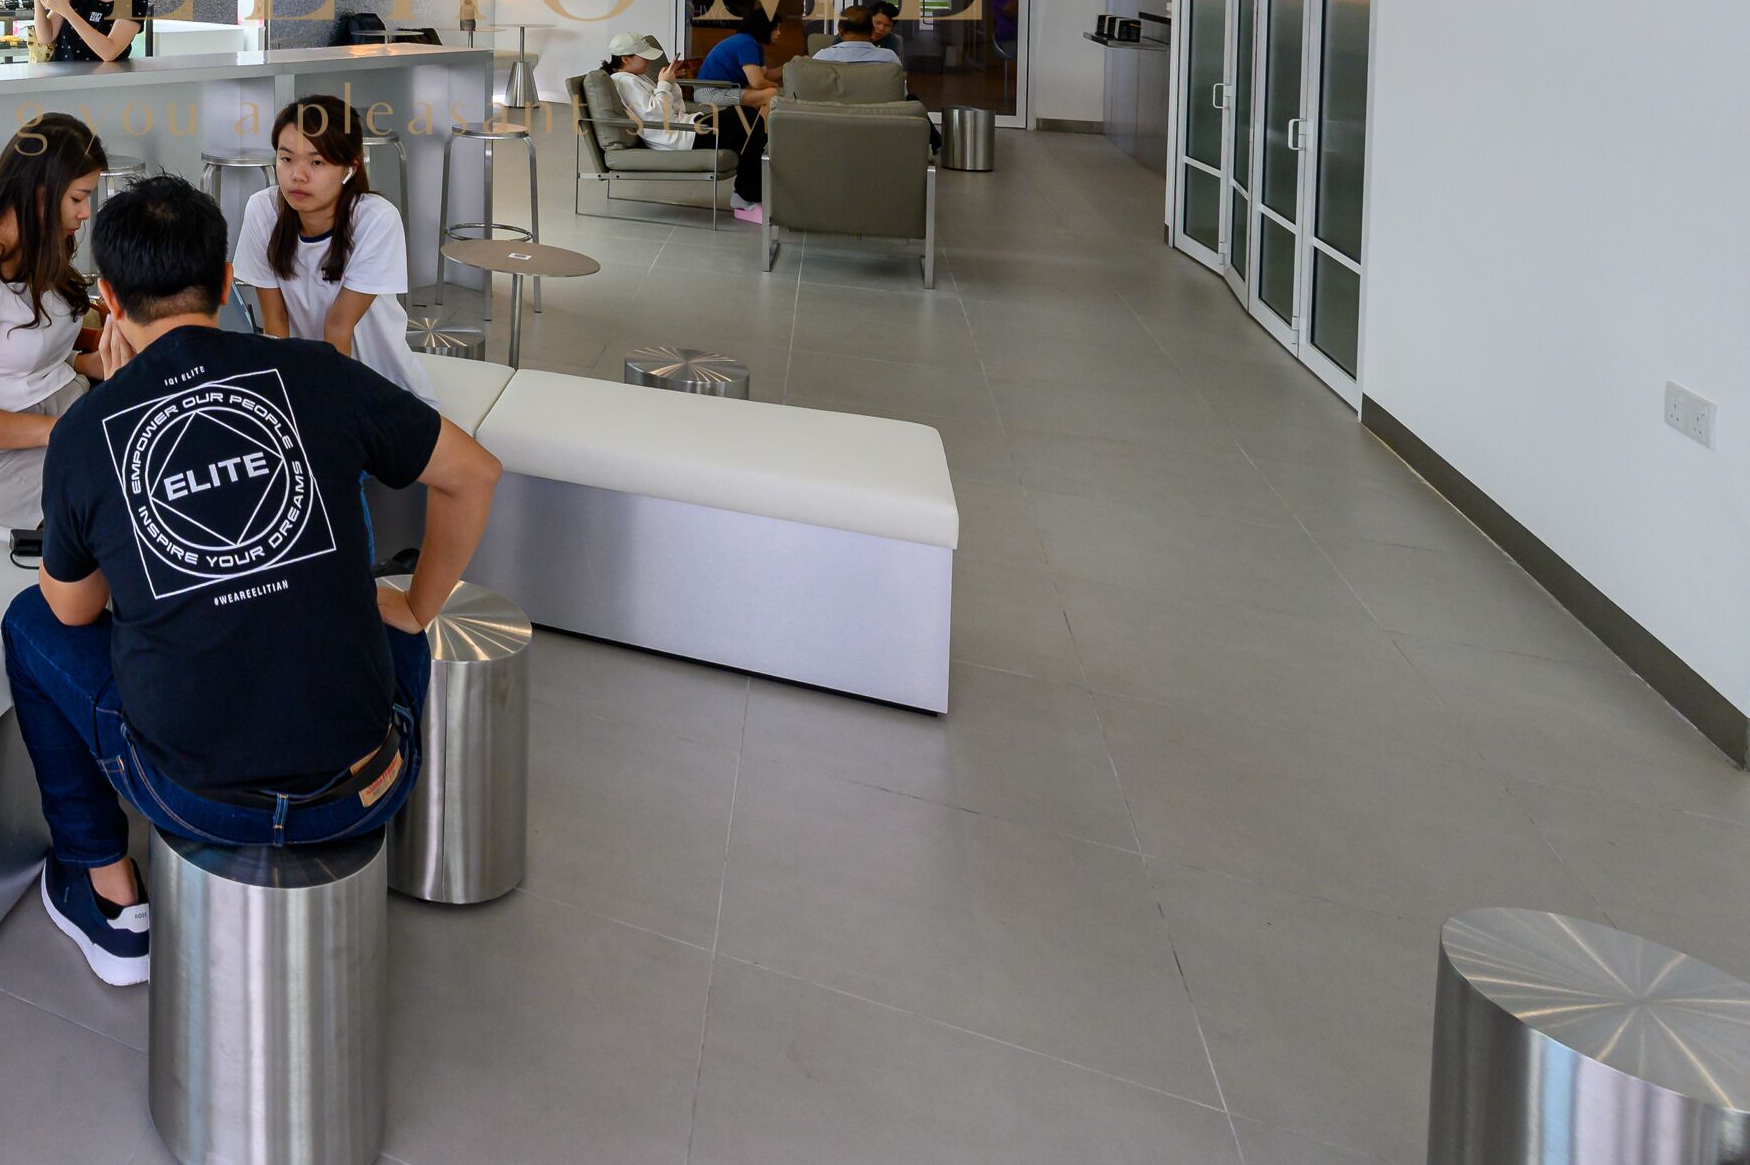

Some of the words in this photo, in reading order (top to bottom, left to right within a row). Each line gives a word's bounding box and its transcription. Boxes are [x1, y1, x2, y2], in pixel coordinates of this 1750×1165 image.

[181, 365, 206, 382] ELITE
[131, 404, 179, 494] EMPOWER
[182, 392, 225, 409] OUR
[229, 393, 294, 450] PEOPLE
[163, 451, 270, 502] ELITE
[138, 505, 199, 566] INSPIRE
[206, 545, 266, 568] YOUR
[268, 460, 305, 549] DREAMS
[213, 579, 290, 607] #WEAREELITIAN
